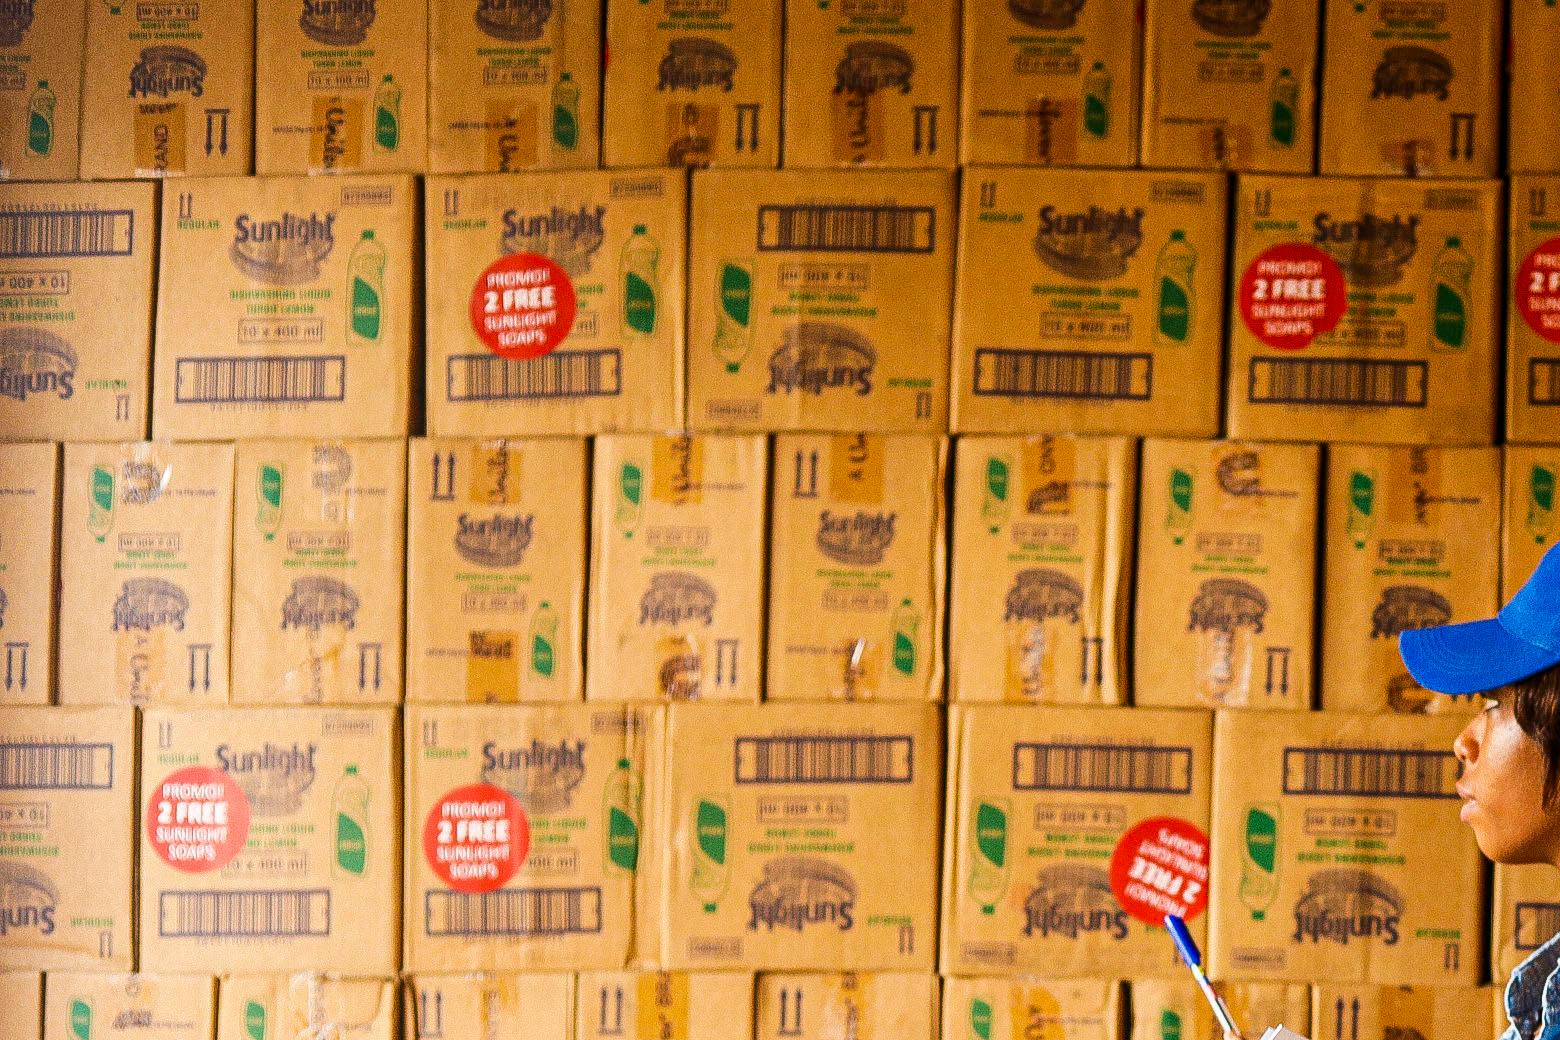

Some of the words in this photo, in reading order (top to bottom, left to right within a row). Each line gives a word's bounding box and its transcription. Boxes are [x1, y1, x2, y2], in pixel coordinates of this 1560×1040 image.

[235, 210, 336, 247] Sunlight
[502, 206, 606, 246] Sunlight
[1039, 205, 1144, 243] Sunlight
[1314, 212, 1419, 252] Sunlight
[1252, 278, 1267, 299] 2
[1271, 278, 1326, 299] FREE
[1530, 271, 1545, 292] 2
[484, 291, 500, 313] 2
[503, 285, 556, 311] FREE
[766, 364, 872, 397] Sunlight
[218, 742, 320, 780] Sunlight
[482, 740, 587, 777] Sunlight
[162, 784, 224, 800] PROMO!
[157, 801, 172, 824] 2
[175, 801, 229, 824] FREE
[155, 826, 228, 842] SUNLIGHT
[437, 820, 451, 843] 2
[455, 819, 509, 842] FREE
[167, 843, 217, 860] SOAPS
[1128, 857, 1184, 895] FREE
[1181, 879, 1201, 903] 2
[749, 896, 855, 931] Sunlight
[1024, 898, 1128, 940] Sunlight
[1293, 904, 1399, 944] Sunlight
